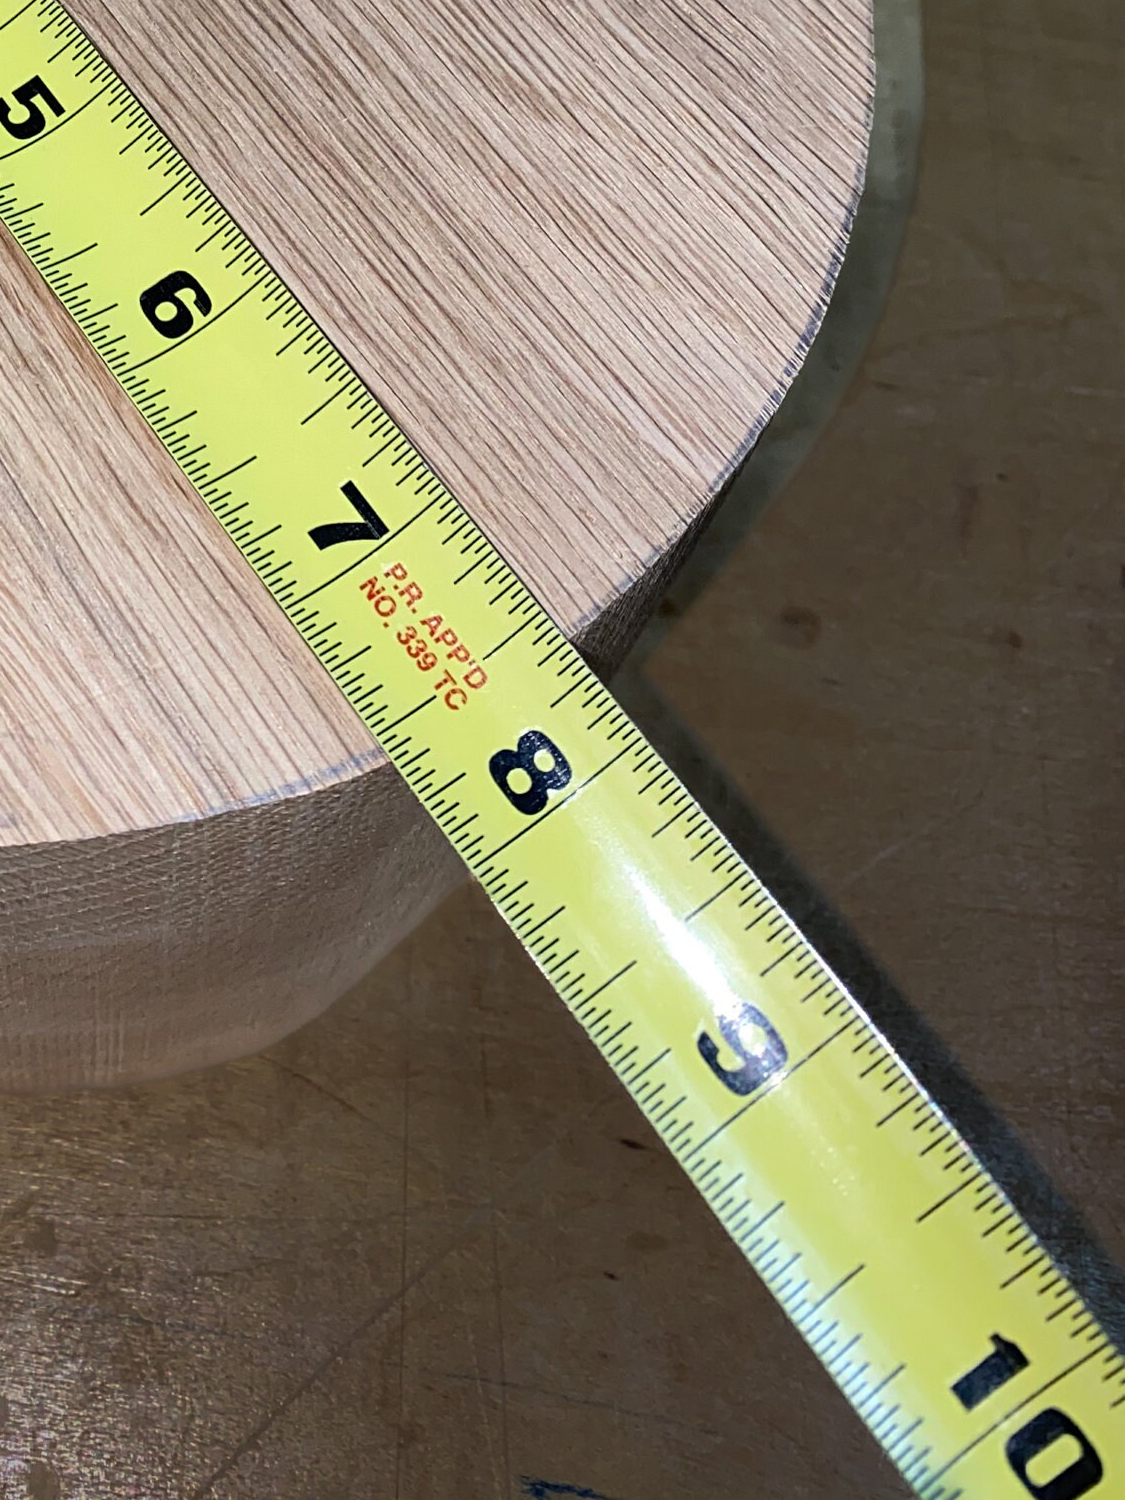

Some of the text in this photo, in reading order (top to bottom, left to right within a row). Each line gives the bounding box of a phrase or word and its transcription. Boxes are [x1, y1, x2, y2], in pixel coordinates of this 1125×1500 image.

[139, 270, 212, 339] 6
[307, 479, 391, 551] 7
[359, 576, 468, 711] NO. 339 TC
[383, 562, 488, 689] P.R. APP'D
[488, 729, 572, 816] 8
[696, 1000, 789, 1097] 9
[950, 1332, 1104, 1500] 10
